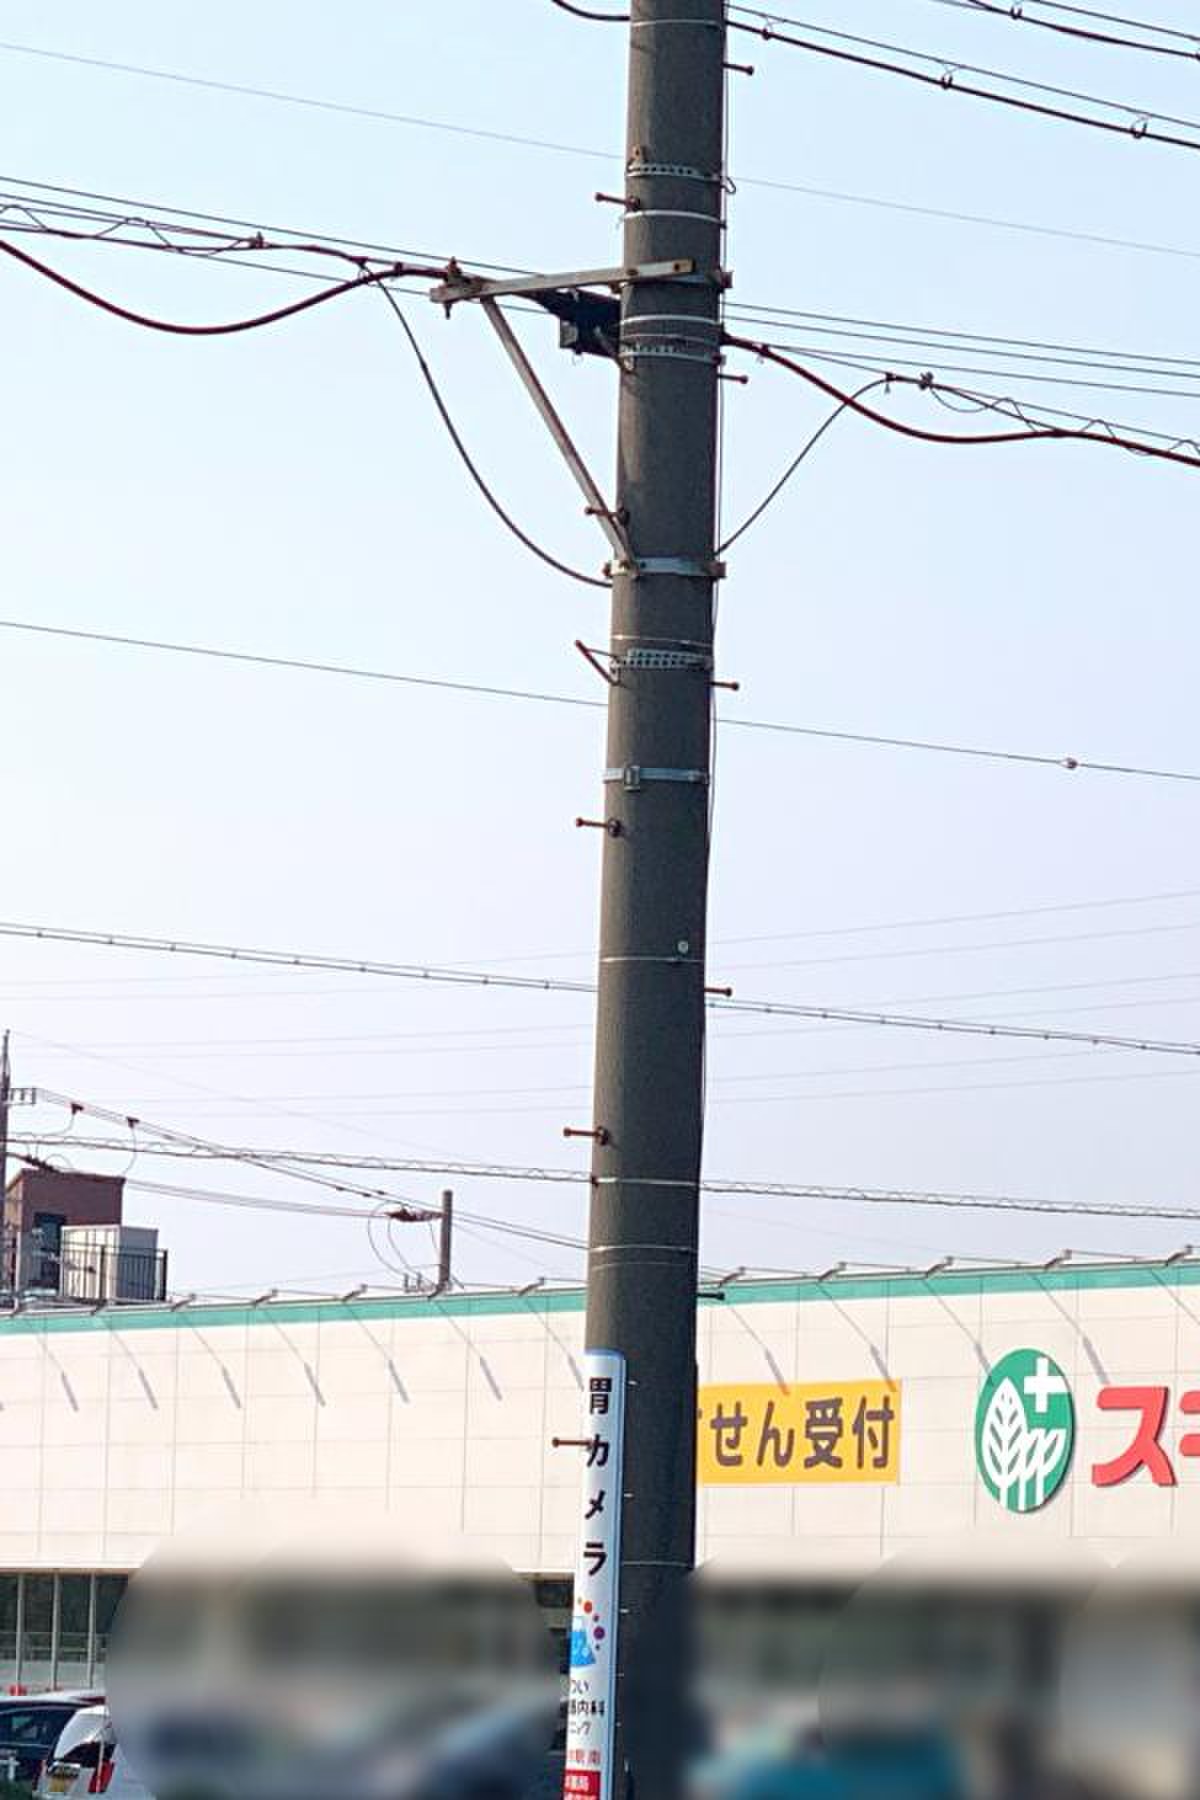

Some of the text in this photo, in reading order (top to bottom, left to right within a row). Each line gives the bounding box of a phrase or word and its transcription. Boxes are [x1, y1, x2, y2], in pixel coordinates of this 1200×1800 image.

[583, 1377, 613, 1578] 胃カメラ
[697, 1396, 895, 1470] せん受付
